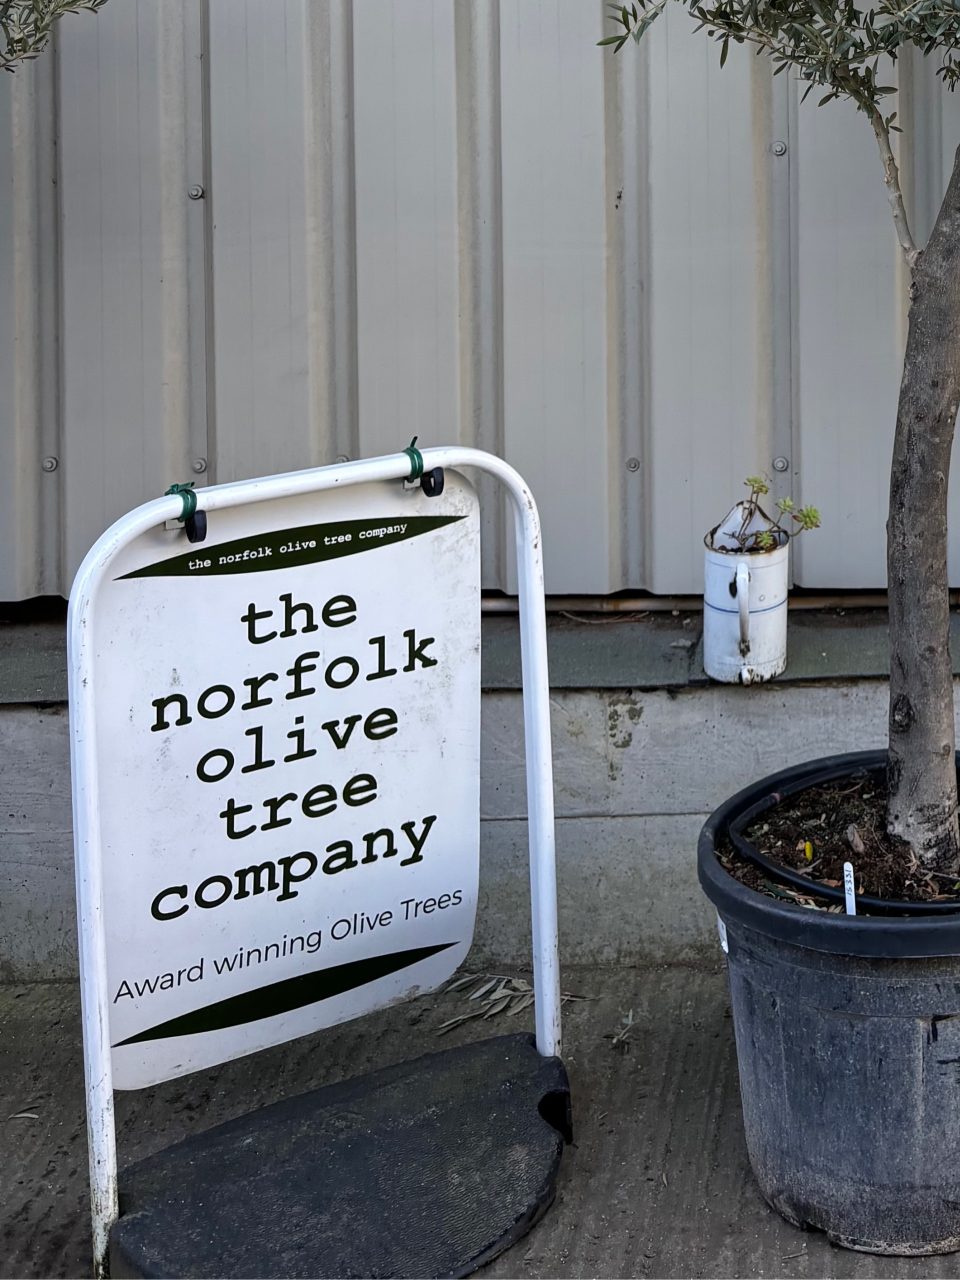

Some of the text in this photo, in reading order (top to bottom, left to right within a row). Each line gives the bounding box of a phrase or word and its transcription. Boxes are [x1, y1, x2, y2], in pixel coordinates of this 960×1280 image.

[188, 523, 408, 570] the norfolk olive tree company
[240, 592, 357, 645] the
[150, 628, 438, 733] norfolk
[196, 707, 398, 783] olive
[219, 773, 378, 840] tree
[150, 814, 438, 922] company
[113, 889, 463, 1004] Award winning Olive Trees
